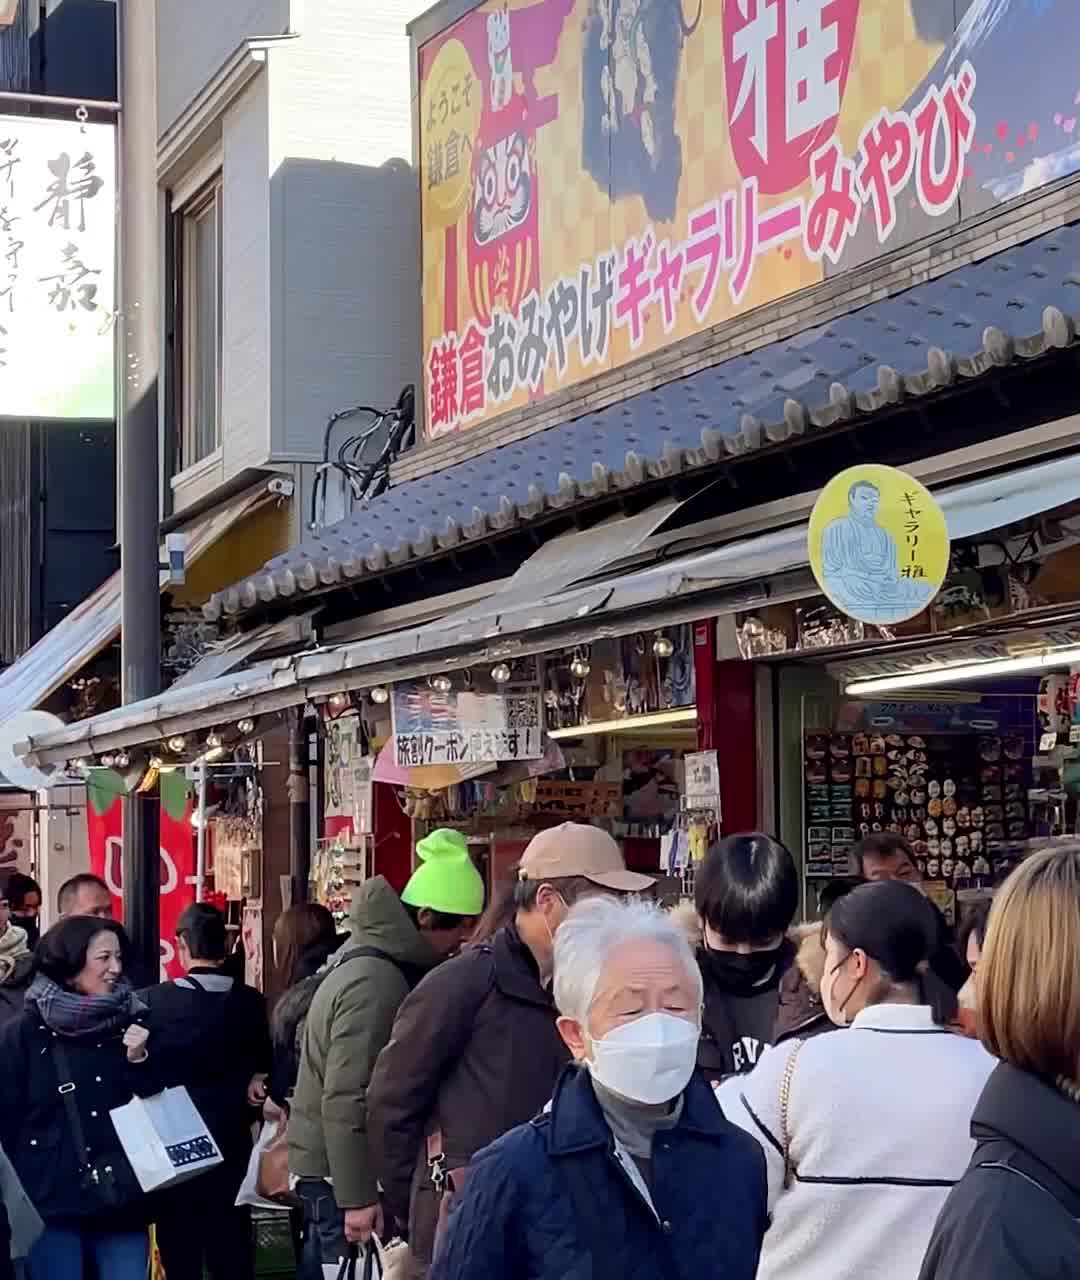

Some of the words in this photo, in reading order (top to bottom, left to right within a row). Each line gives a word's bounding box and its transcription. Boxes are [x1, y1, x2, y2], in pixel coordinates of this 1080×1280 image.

[426, 71, 473, 132] ようこそ
[428, 61, 977, 436] 鎌倉おみやげギャラリーみやび
[897, 489, 928, 579] ギャラリー雅
